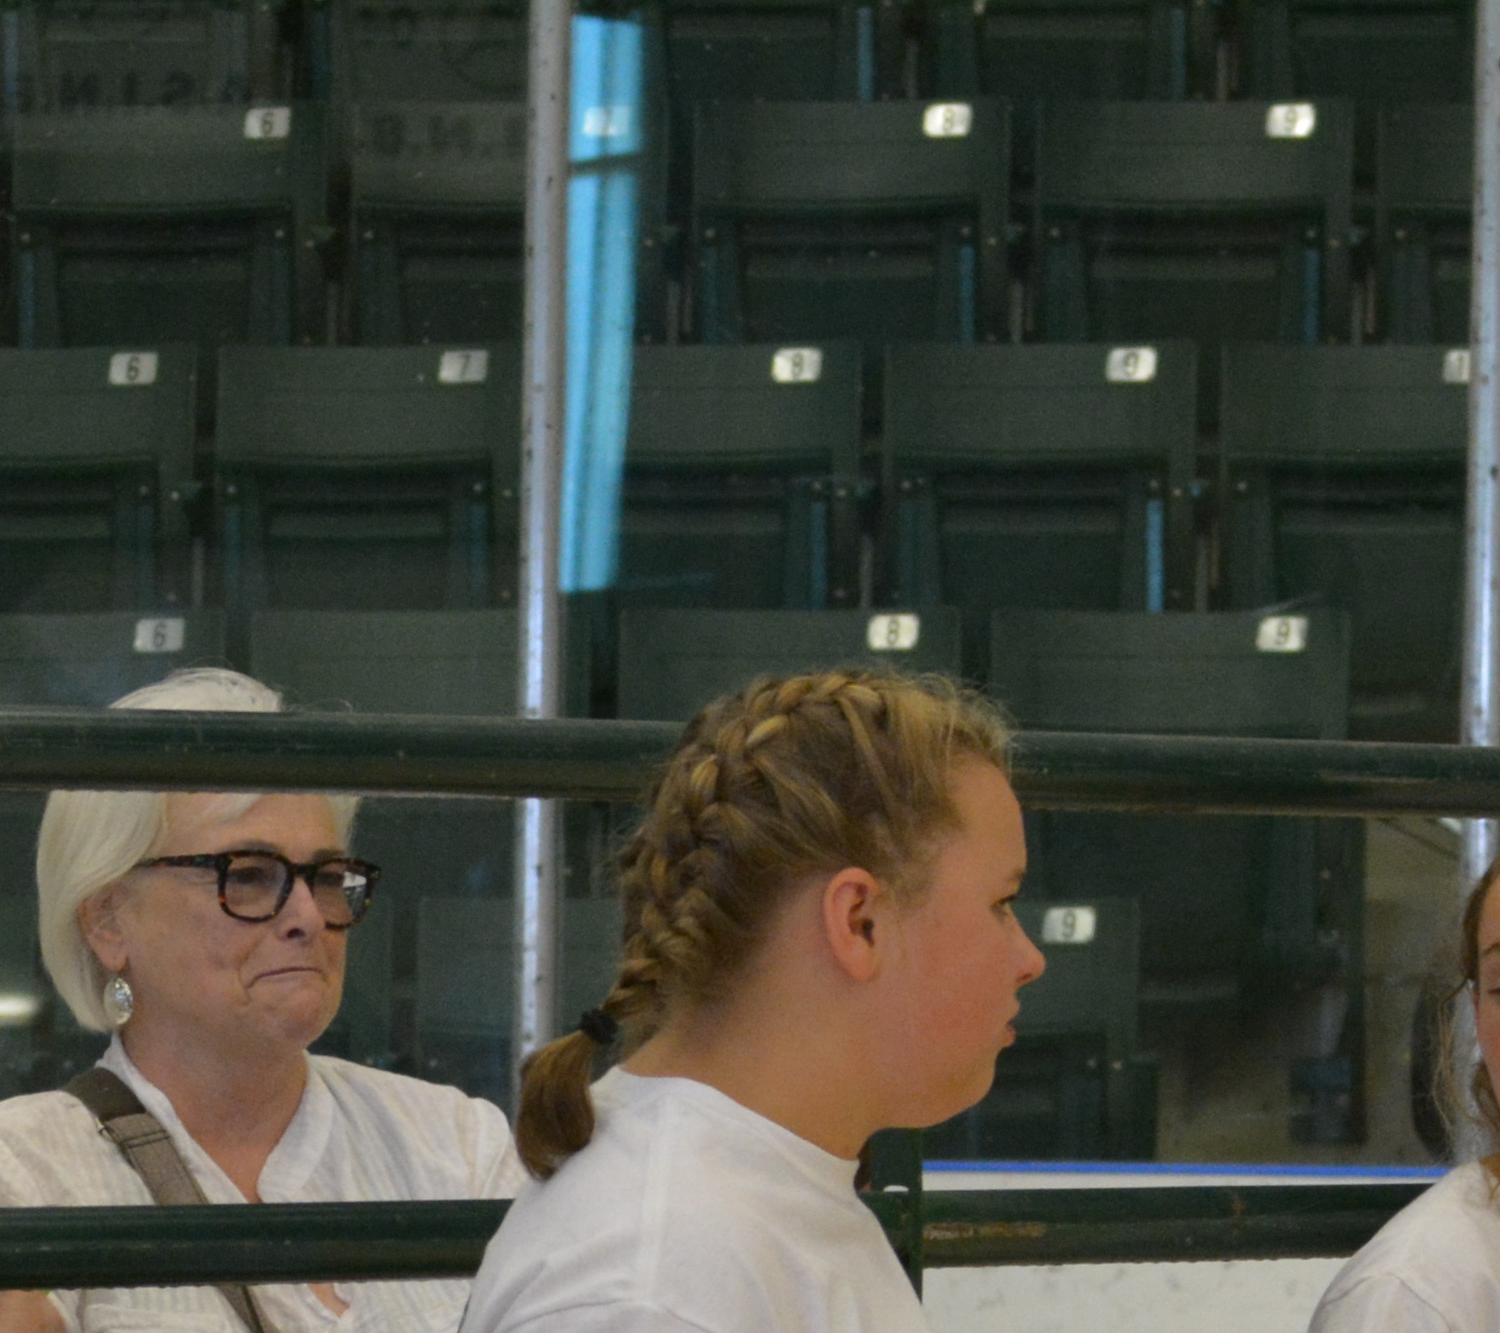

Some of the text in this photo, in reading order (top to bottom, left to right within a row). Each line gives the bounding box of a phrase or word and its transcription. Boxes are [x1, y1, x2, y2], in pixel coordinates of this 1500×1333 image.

[260, 111, 274, 136] 6
[126, 355, 140, 381] 6
[458, 353, 471, 380] 7
[1125, 350, 1140, 377] 9
[152, 620, 167, 648] 6
[887, 618, 900, 646] 8
[1275, 619, 1290, 646] 9
[1062, 909, 1076, 938] 9
